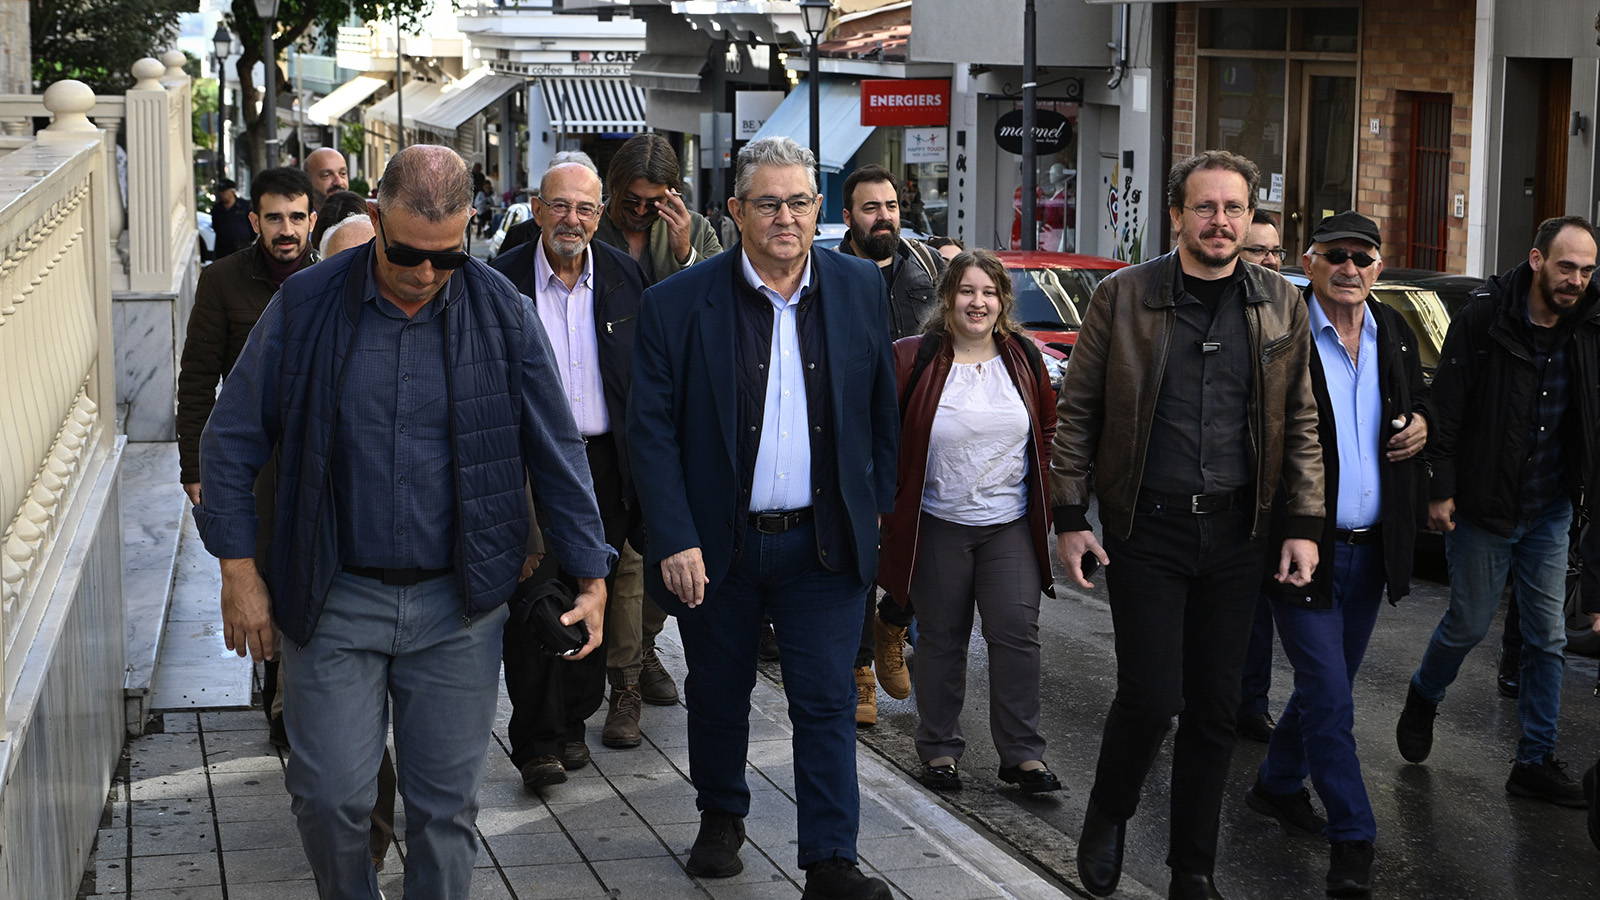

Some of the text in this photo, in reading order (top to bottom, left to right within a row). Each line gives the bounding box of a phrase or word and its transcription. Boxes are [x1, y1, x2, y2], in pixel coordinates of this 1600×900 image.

[571, 51, 638, 62] BX CAFE
[532, 63, 563, 74] coffee
[574, 63, 598, 74] fresh
[600, 64, 620, 76] juice
[870, 94, 942, 107] ENERGIERS
[742, 120, 755, 129] BE
[999, 121, 1066, 138] mamel
